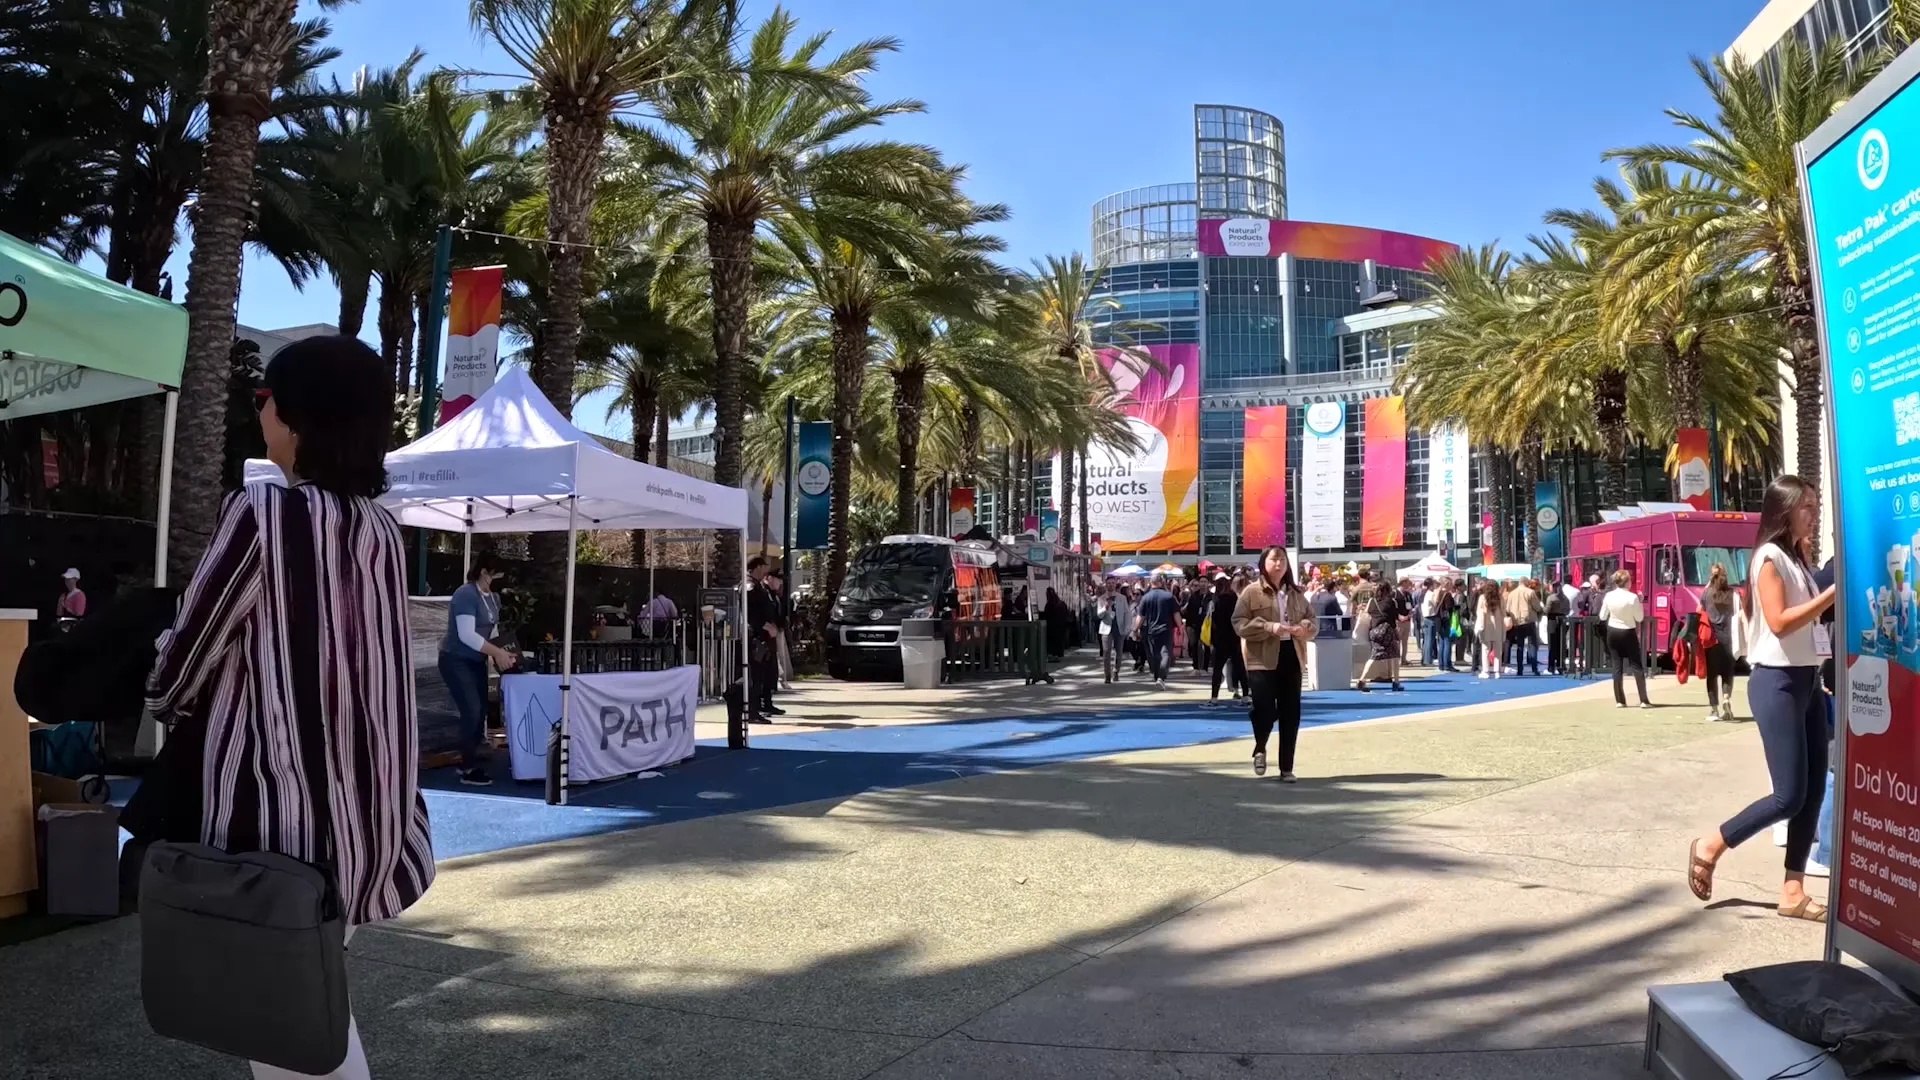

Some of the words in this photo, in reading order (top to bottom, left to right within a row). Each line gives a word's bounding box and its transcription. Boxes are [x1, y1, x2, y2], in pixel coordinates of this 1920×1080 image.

[1835, 225, 1864, 252] Tetra
[1838, 241, 1874, 267] Unlocking
[453, 363, 486, 371] Products
[454, 354, 481, 362] Natural
[1210, 398, 1289, 408] ANAHEIM
[1072, 462, 1132, 479] tural
[1870, 478, 1886, 491] Visit
[1887, 478, 1897, 487] us
[1898, 474, 1906, 486] at
[1072, 502, 1103, 514] XPO
[1107, 501, 1149, 513] WEST
[1444, 470, 1453, 531] NETWOR
[1852, 680, 1877, 693] Natural
[1852, 692, 1882, 706] Products
[1852, 705, 1867, 715] EXPO
[1867, 707, 1884, 717] WEST
[600, 694, 687, 750] PATH
[1854, 763, 1881, 794] Did
[1887, 770, 1918, 805] You
[1853, 808, 1861, 823] At
[1863, 812, 1882, 832] Expo
[1884, 818, 1906, 839] West
[1852, 830, 1886, 855] Network
[1850, 852, 1868, 871] 52%
[1869, 862, 1878, 875] of
[1879, 866, 1889, 880] all
[1891, 872, 1917, 892] waste
[1848, 878, 1857, 889] at
[1859, 880, 1872, 896] the
[1873, 887, 1897, 908] show.
